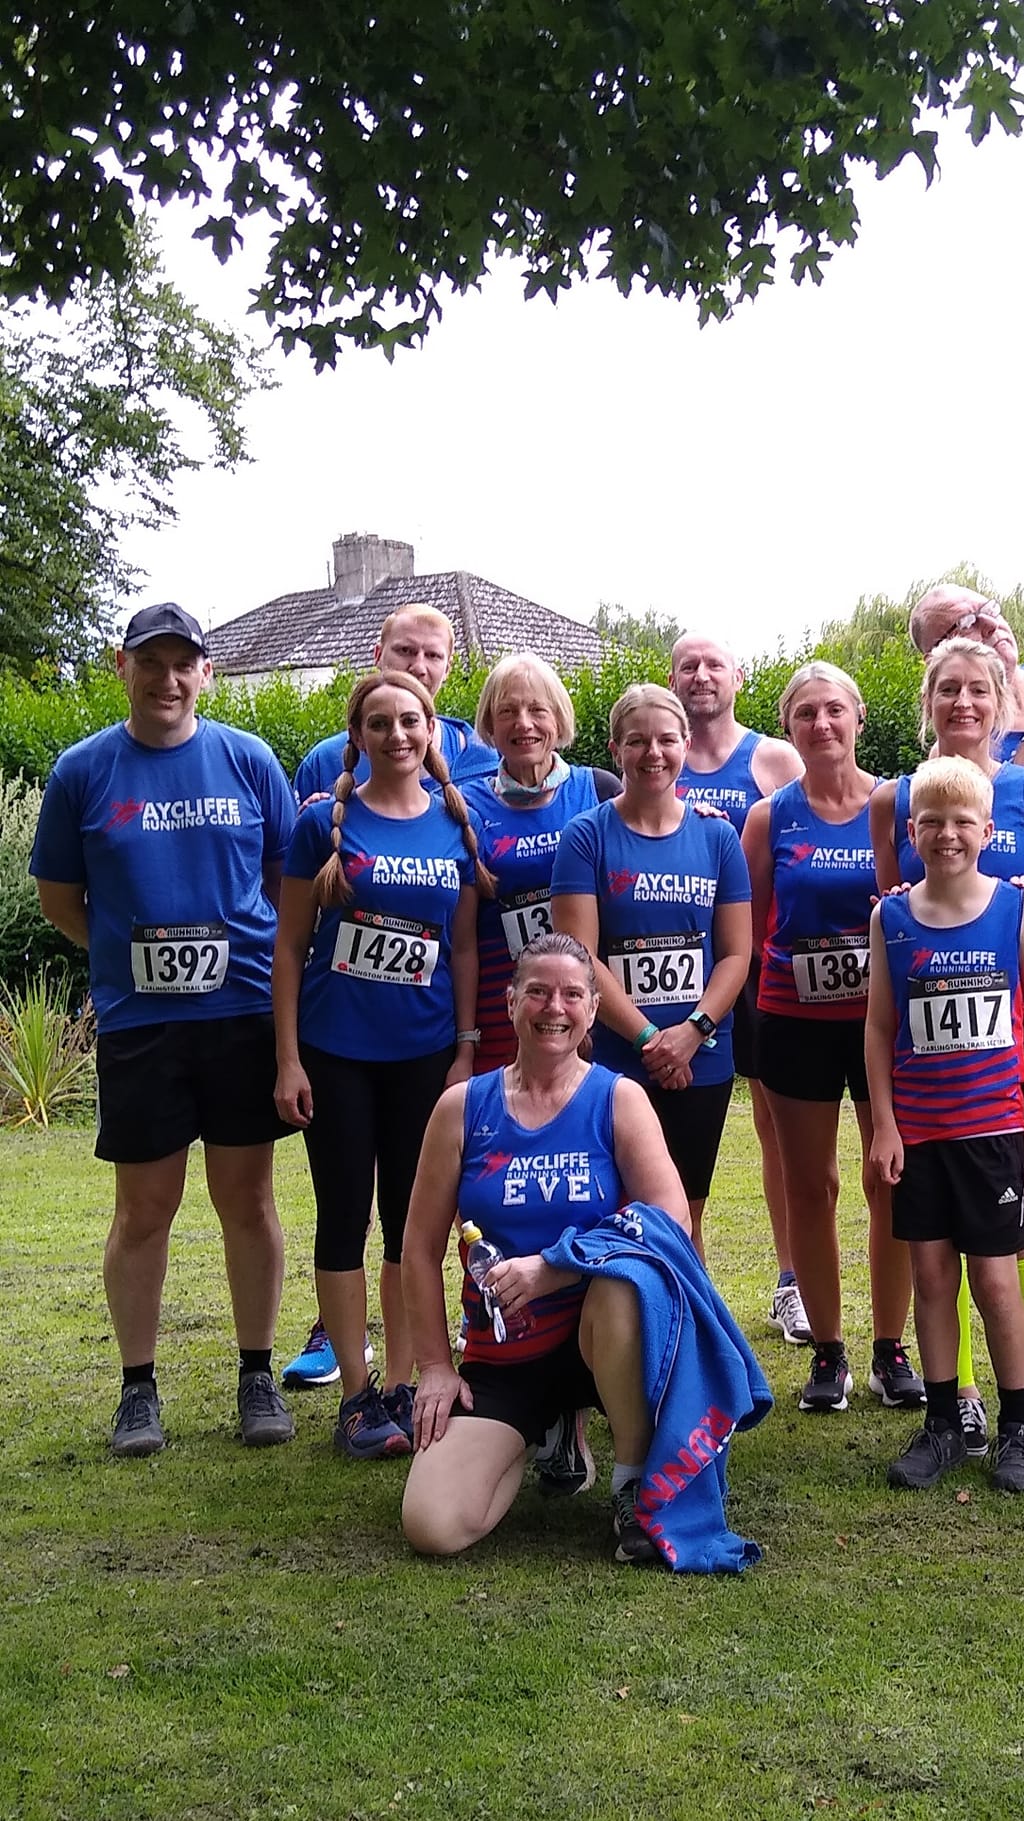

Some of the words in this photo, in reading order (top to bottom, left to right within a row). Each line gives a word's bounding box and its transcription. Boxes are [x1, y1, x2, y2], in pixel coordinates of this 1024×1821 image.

[686, 788, 747, 802] AYCLIFFE
[142, 798, 240, 820] AYCLIFFE
[725, 801, 746, 809] CLUB
[142, 816, 205, 831] RUNNING
[210, 814, 241, 826] CLUB
[516, 830, 563, 850] AYCLI
[990, 844, 1016, 854] CLUB
[812, 847, 875, 862] AYCLIFF
[810, 861, 856, 869] RUNNING
[372, 872, 437, 887] RUNNING
[441, 877, 459, 890] CLU
[635, 873, 718, 897] AYCLIFFE
[633, 890, 691, 904] RUNNING
[516, 906, 554, 947] 13
[348, 927, 427, 974] 1428
[930, 951, 996, 966] AYCLIFFE
[143, 944, 219, 983] 1392
[930, 965, 971, 973] RUNNING
[623, 953, 695, 995] 1362
[923, 995, 1002, 1042] 1417
[508, 1152, 589, 1171] AYCLIFFE
[506, 1169, 558, 1180] RUNNING
[503, 1175, 590, 1206] EVE
